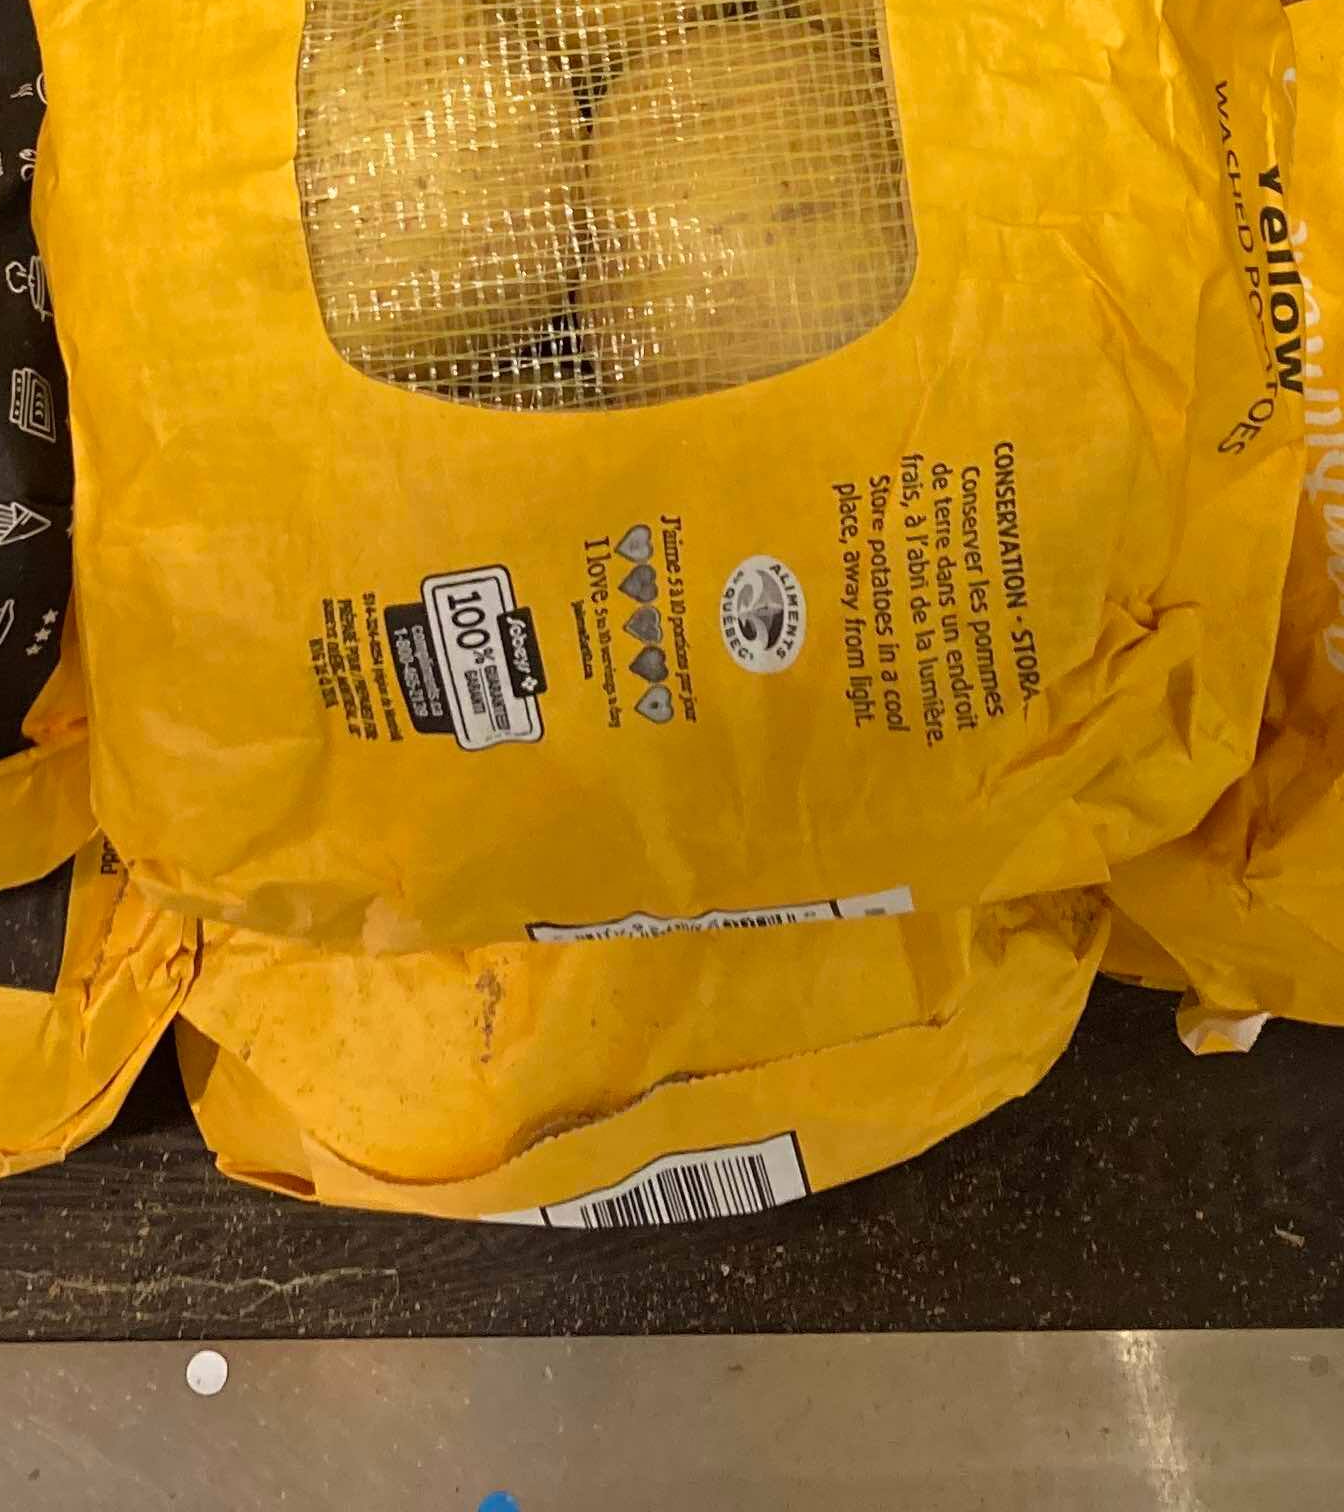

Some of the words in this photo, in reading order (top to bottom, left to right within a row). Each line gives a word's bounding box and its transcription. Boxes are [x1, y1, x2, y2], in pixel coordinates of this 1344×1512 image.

[869, 473, 892, 532] Store
[899, 453, 925, 508] frais,
[931, 462, 953, 490] de
[831, 481, 863, 544] place,
[904, 514, 928, 528] à
[934, 496, 955, 549] terre
[960, 465, 984, 574] Conserver
[993, 441, 1029, 610] CONSERVATION
[584, 536, 611, 551] I
[660, 514, 684, 574] J'aime
[585, 553, 612, 604] love
[839, 549, 862, 612] away
[867, 538, 897, 637] potatoes
[936, 555, 957, 607] dans
[967, 580, 991, 613] les
[446, 591, 496, 666] 100%
[768, 563, 799, 660] ALIMENTS
[909, 595, 932, 625] de
[941, 614, 960, 643] un
[843, 616, 868, 669] from
[876, 642, 900, 664] in
[913, 629, 937, 652] la
[1010, 628, 1041, 702] STORA
[880, 669, 898, 683] a
[945, 649, 979, 731] endroit
[967, 620, 1005, 718] pommes
[845, 674, 877, 729] light.
[882, 688, 911, 733] cool
[918, 658, 947, 748] lumière.
